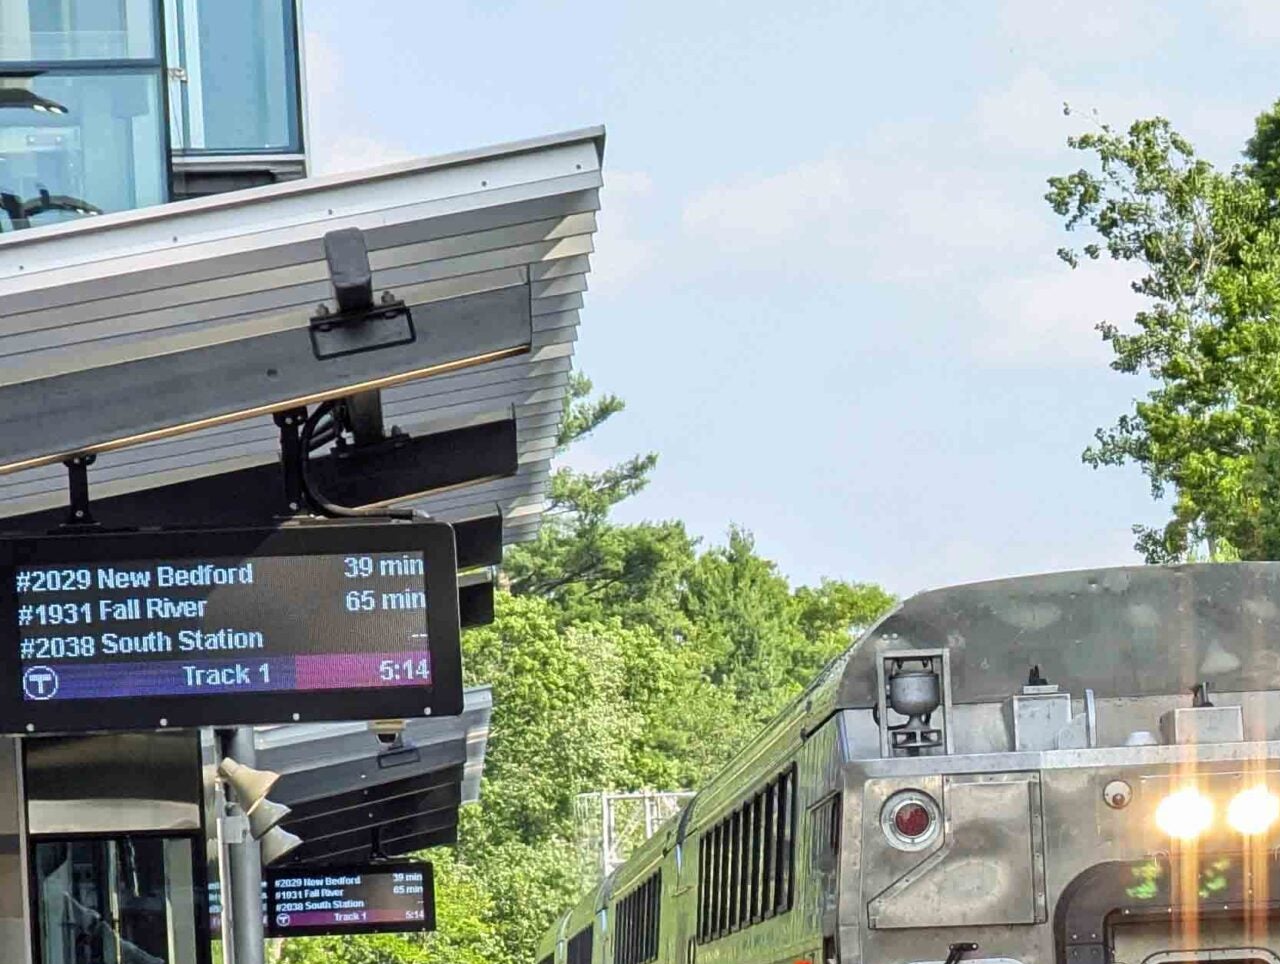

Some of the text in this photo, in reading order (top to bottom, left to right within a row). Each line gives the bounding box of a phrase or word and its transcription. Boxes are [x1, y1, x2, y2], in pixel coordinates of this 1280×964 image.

[344, 555, 424, 577] 39 min
[16, 563, 253, 592] #2029 New Bedford
[346, 588, 426, 611] 65 min
[18, 597, 207, 625] #1931 Fall River
[20, 628, 263, 659] #2038 South Station
[183, 664, 270, 687] Track 1
[380, 660, 430, 680] 5:14
[304, 877, 324, 886] New
[325, 875, 361, 885] Bedford
[392, 872, 423, 882] 39 min
[304, 889, 320, 898] Fall
[321, 888, 344, 898] River
[406, 885, 423, 894] min
[305, 901, 332, 910] South
[332, 899, 365, 909] Station
[334, 912, 360, 921] Track
